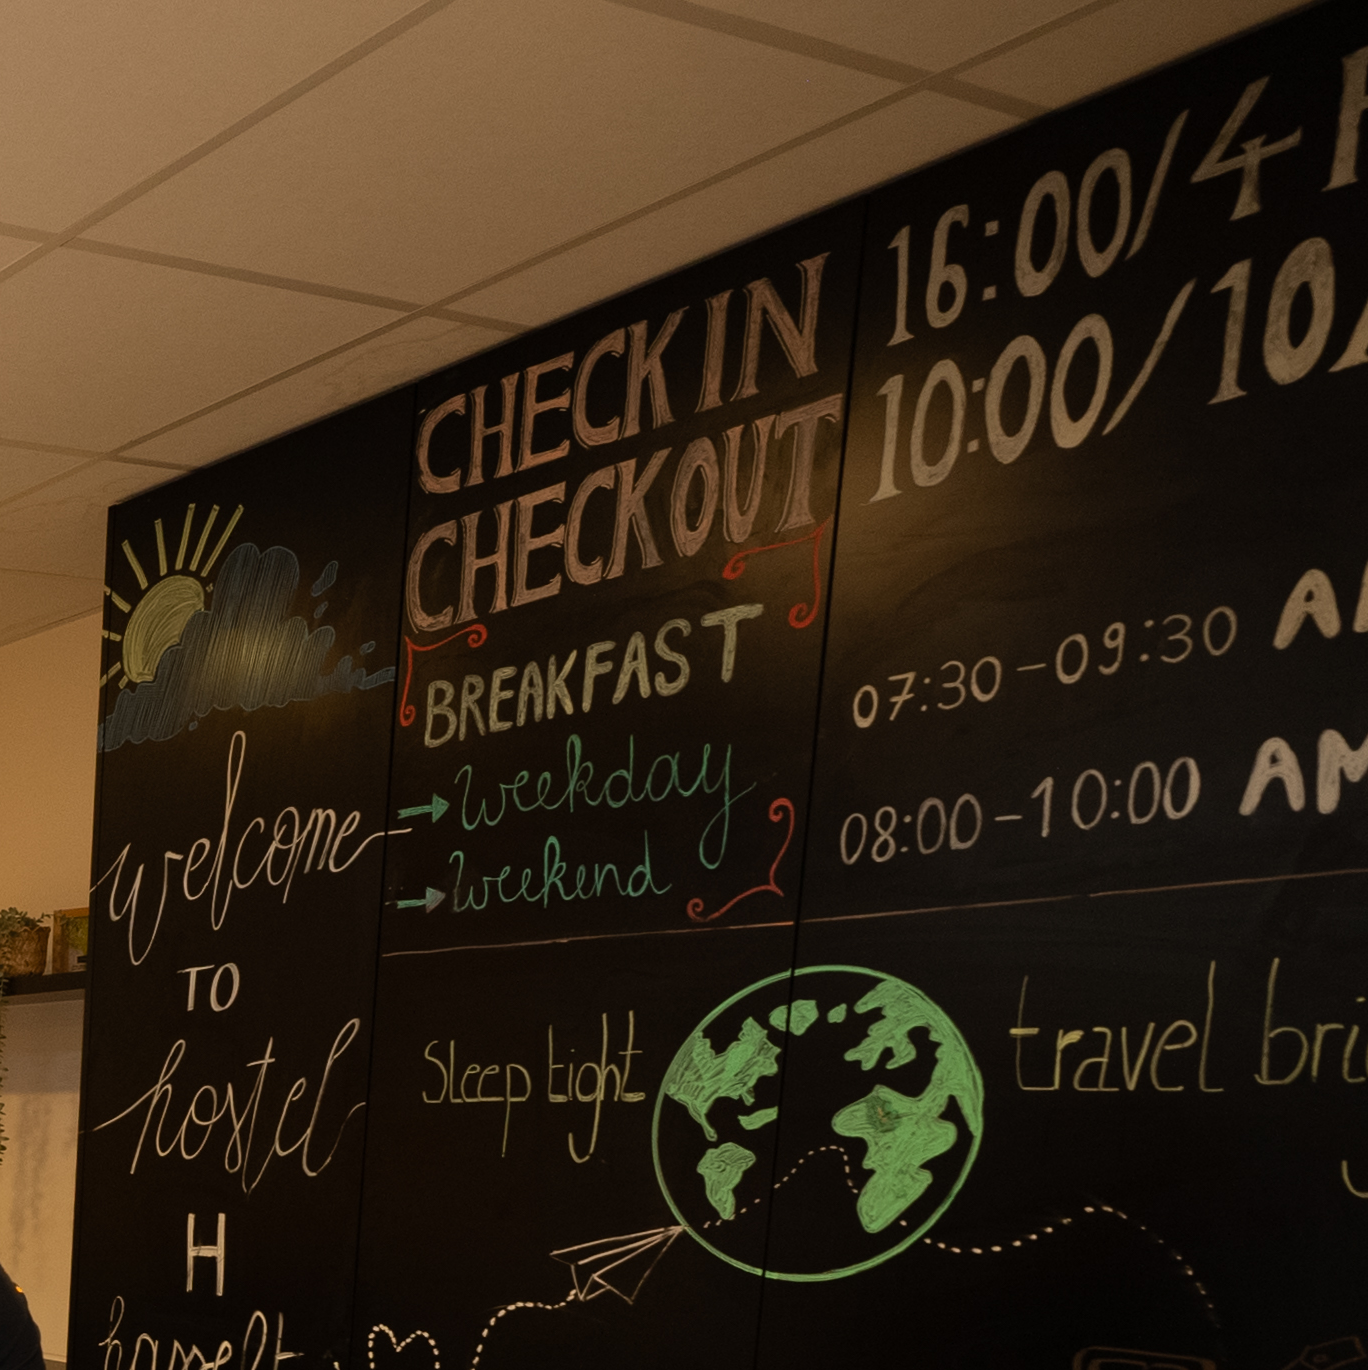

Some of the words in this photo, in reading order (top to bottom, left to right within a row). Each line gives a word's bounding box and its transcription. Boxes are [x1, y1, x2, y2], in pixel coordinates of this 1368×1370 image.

[416, 306, 690, 494] CHECK
[695, 251, 831, 413] IN
[1272, 560, 1368, 650] A
[424, 603, 764, 748] BREAKFAST
[176, 962, 240, 1012] TO
[1009, 960, 1225, 1092] travel
[1254, 957, 1368, 1085] bri
[186, 1212, 226, 1297] H
